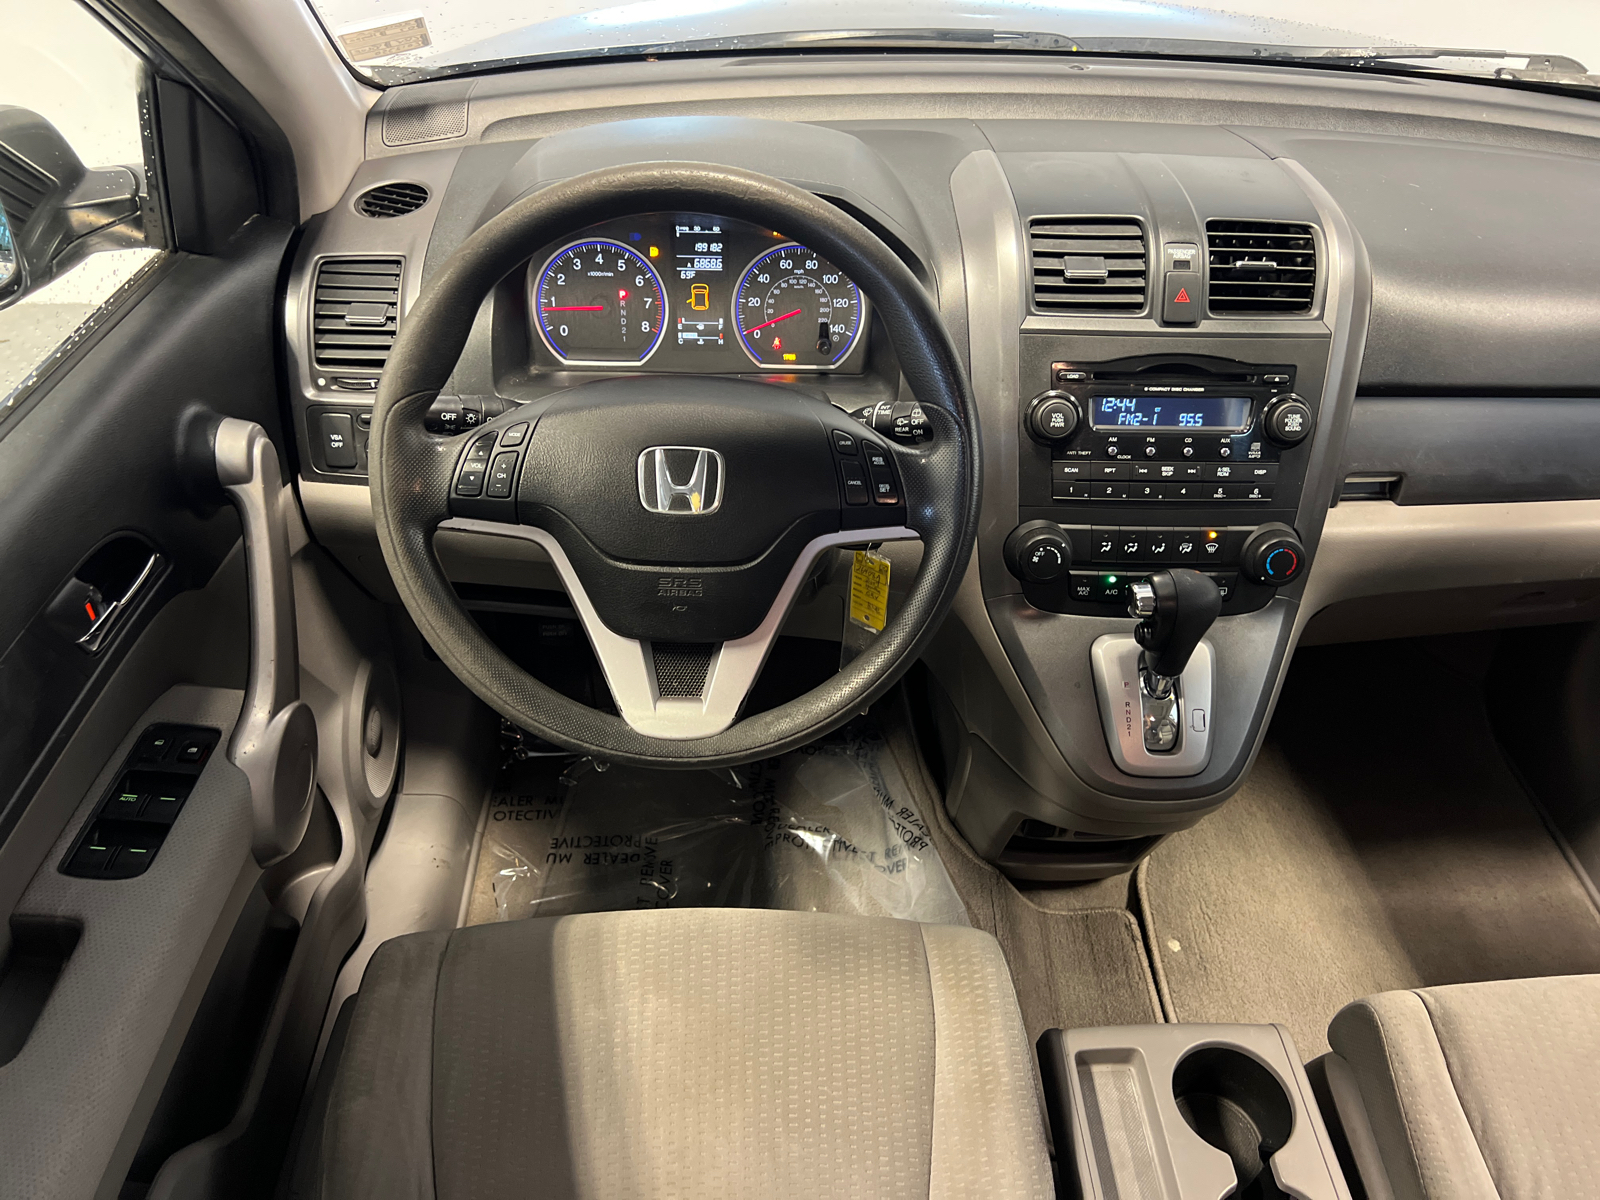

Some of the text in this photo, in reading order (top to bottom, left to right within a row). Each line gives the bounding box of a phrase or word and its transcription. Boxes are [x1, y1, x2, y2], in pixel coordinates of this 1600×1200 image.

[573, 258, 581, 270] 3
[595, 253, 604, 264] 4
[617, 260, 626, 271] 5
[780, 260, 792, 269] 60
[805, 260, 818, 269] 80
[557, 274, 565, 285] 2
[635, 275, 644, 287] 6
[758, 274, 770, 283] 40
[822, 274, 838, 284] 100
[619, 290, 626, 299] P
[551, 296, 555, 307] 1
[644, 298, 652, 309] 7
[748, 298, 760, 306] 20
[833, 298, 848, 308] 120
[560, 325, 568, 336] 0
[641, 321, 650, 332] 8
[830, 324, 845, 333] 140
[753, 329, 760, 338] 0
[1102, 398, 1136, 412] 12:44
[658, 578, 702, 587] SRS
[550, 835, 641, 849] PROTECTIVE
[584, 852, 640, 865] DEALER
